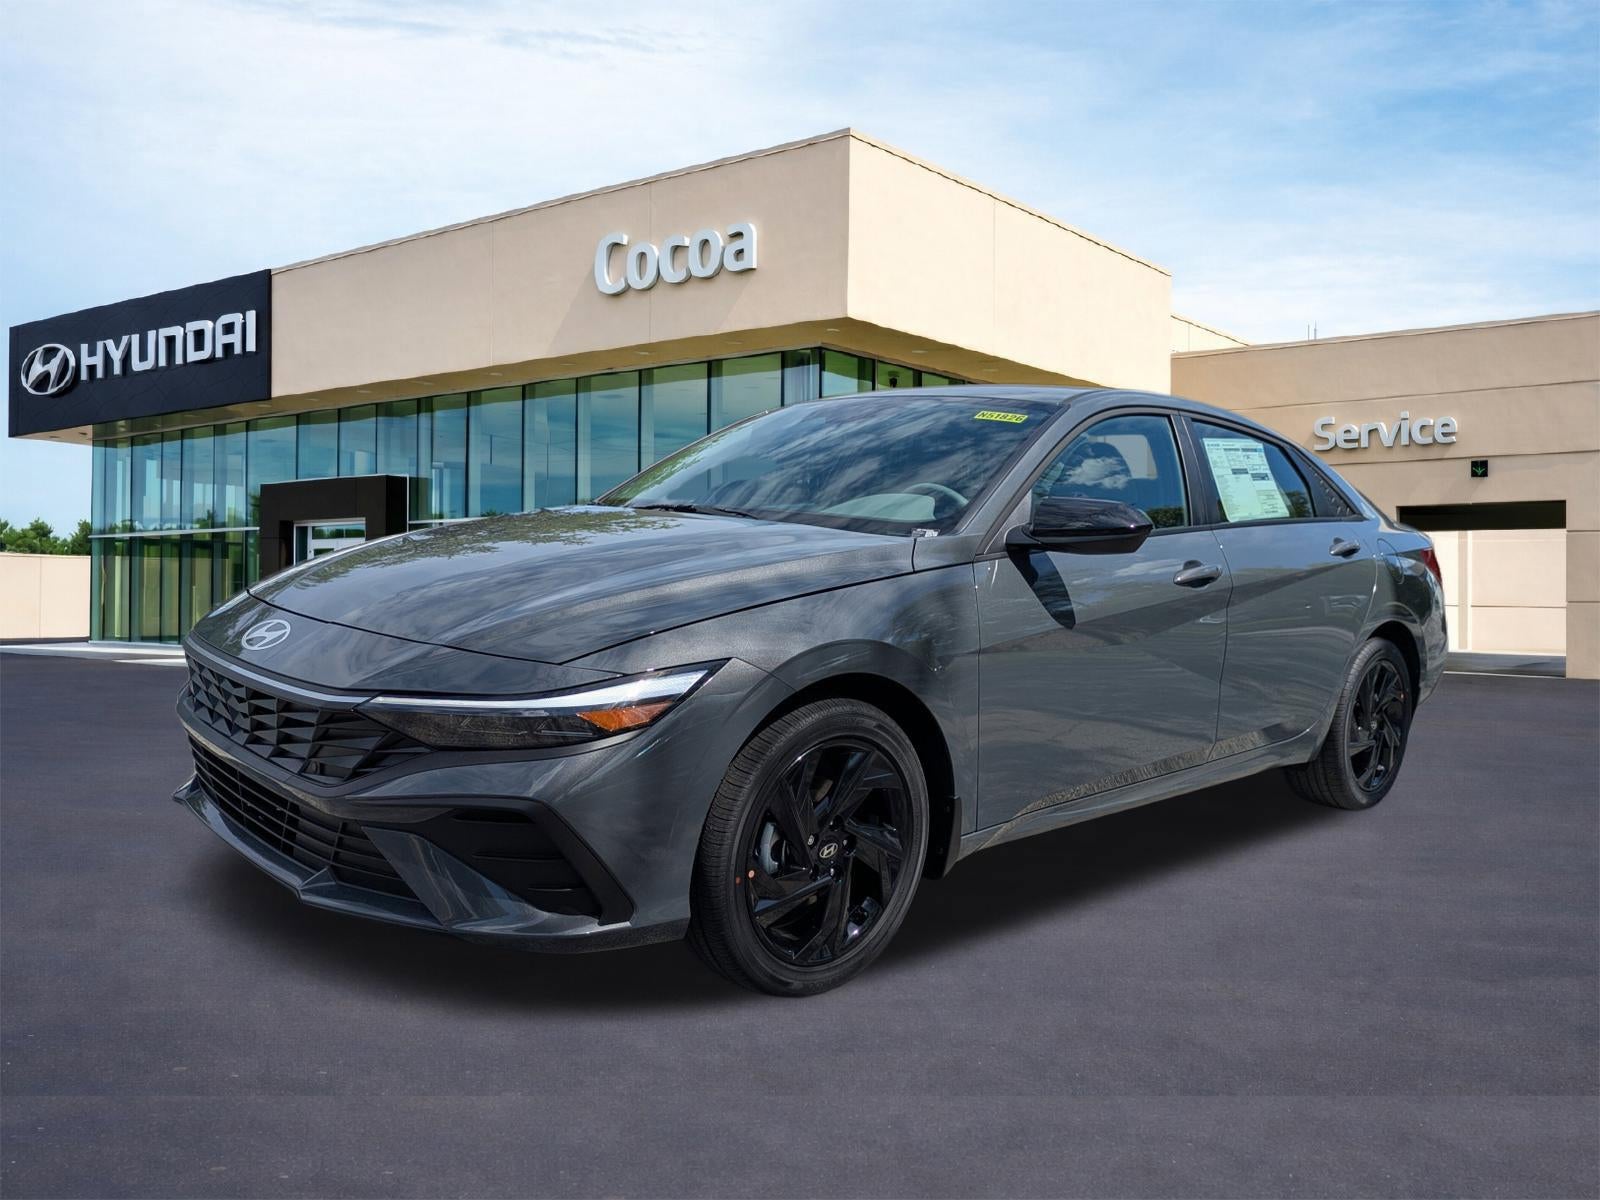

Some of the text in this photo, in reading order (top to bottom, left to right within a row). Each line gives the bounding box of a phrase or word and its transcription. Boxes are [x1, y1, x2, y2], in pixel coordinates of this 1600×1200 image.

[594, 223, 758, 296] Cocoa
[80, 310, 257, 382] HYUNDAI
[1313, 411, 1458, 451] Service
